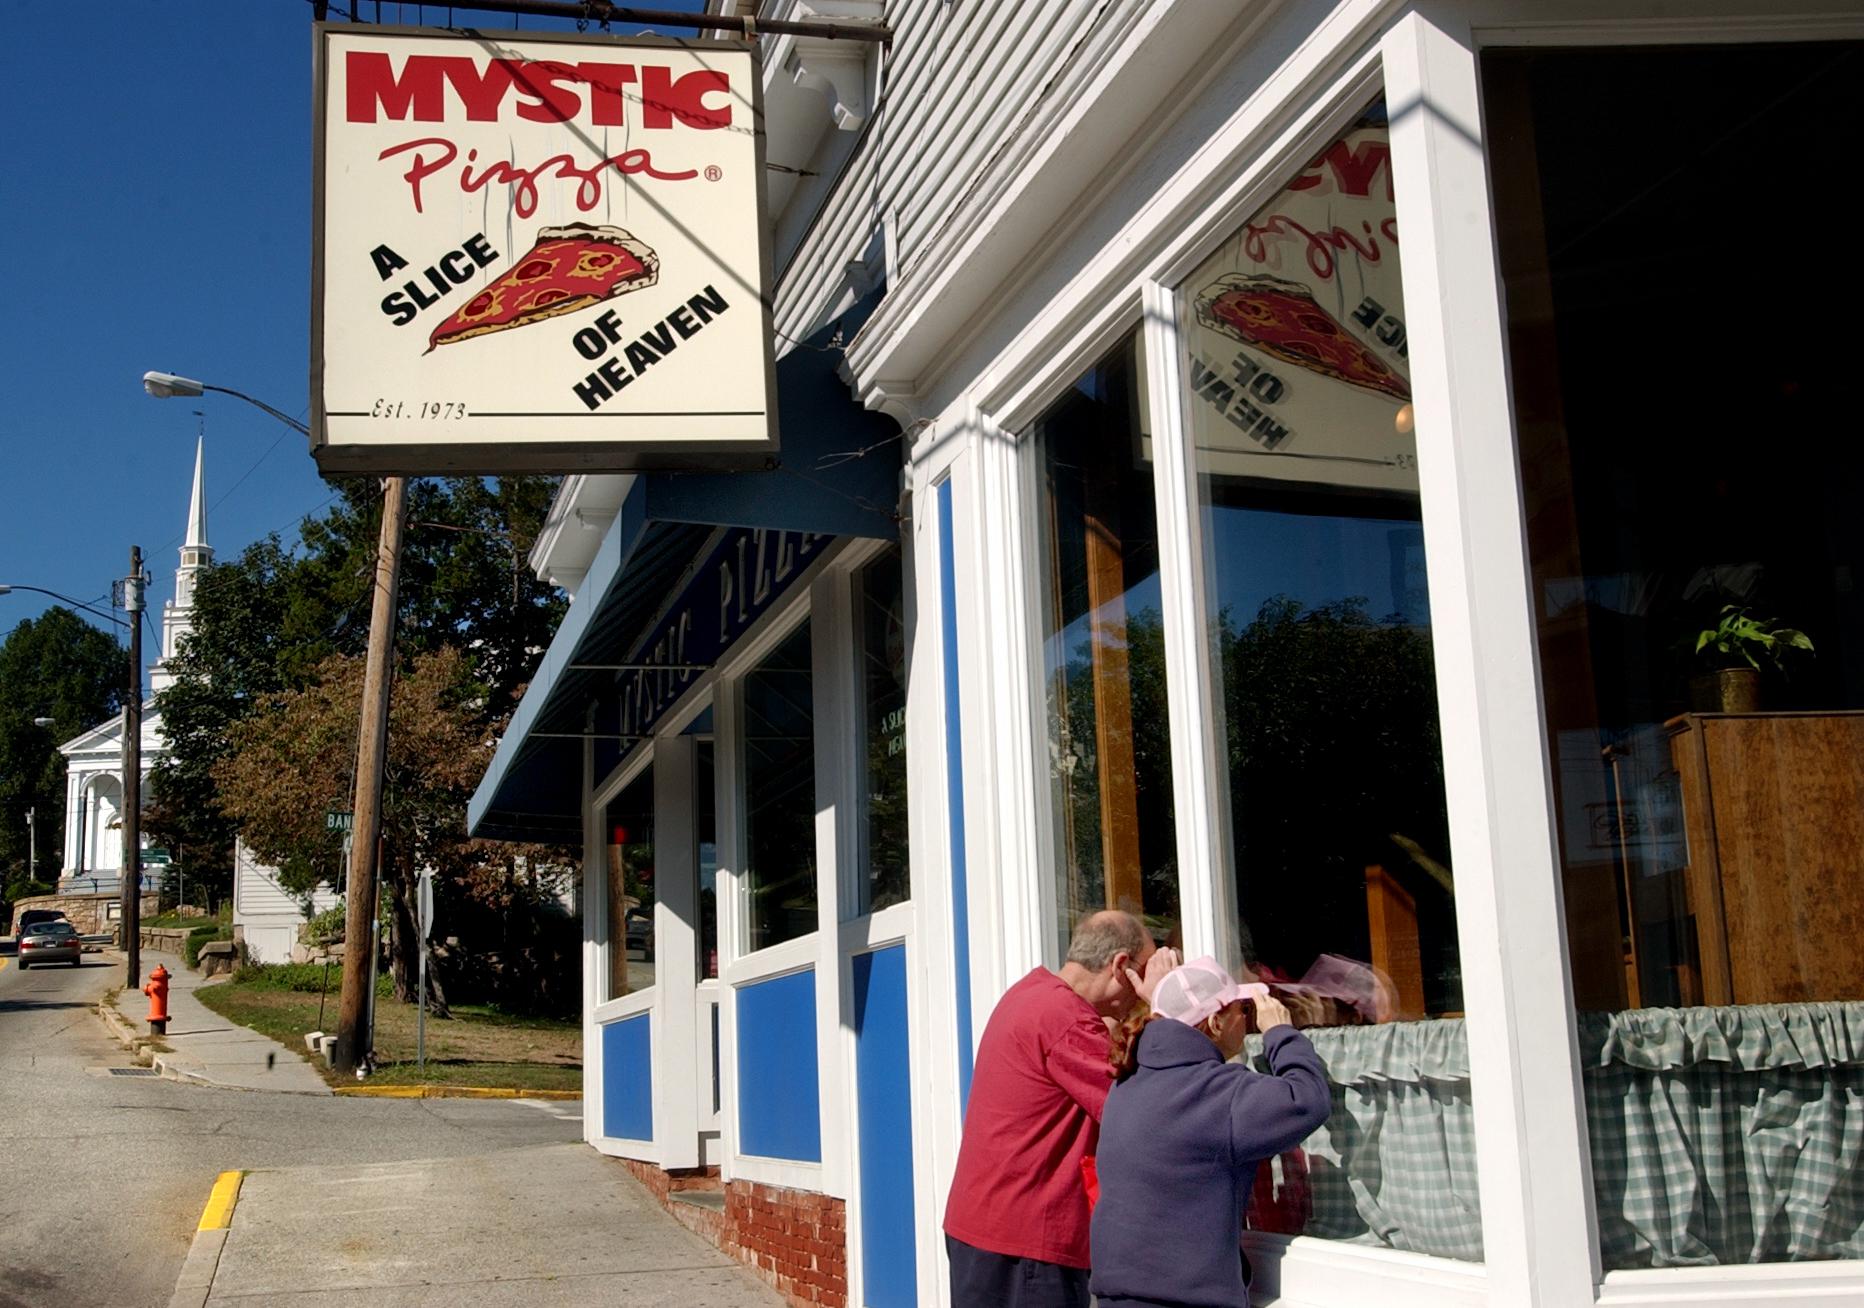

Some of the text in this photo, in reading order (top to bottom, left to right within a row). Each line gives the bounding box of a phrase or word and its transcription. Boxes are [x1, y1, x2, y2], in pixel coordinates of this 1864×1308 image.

[346, 51, 733, 130] MYSTIC
[379, 137, 698, 219] Pizza
[370, 244, 409, 281] A
[380, 232, 501, 326] SLICE
[572, 308, 623, 361] OF
[572, 284, 730, 411] HEAVEN
[372, 398, 466, 420] Est. 1973
[327, 813, 355, 829] BAN
